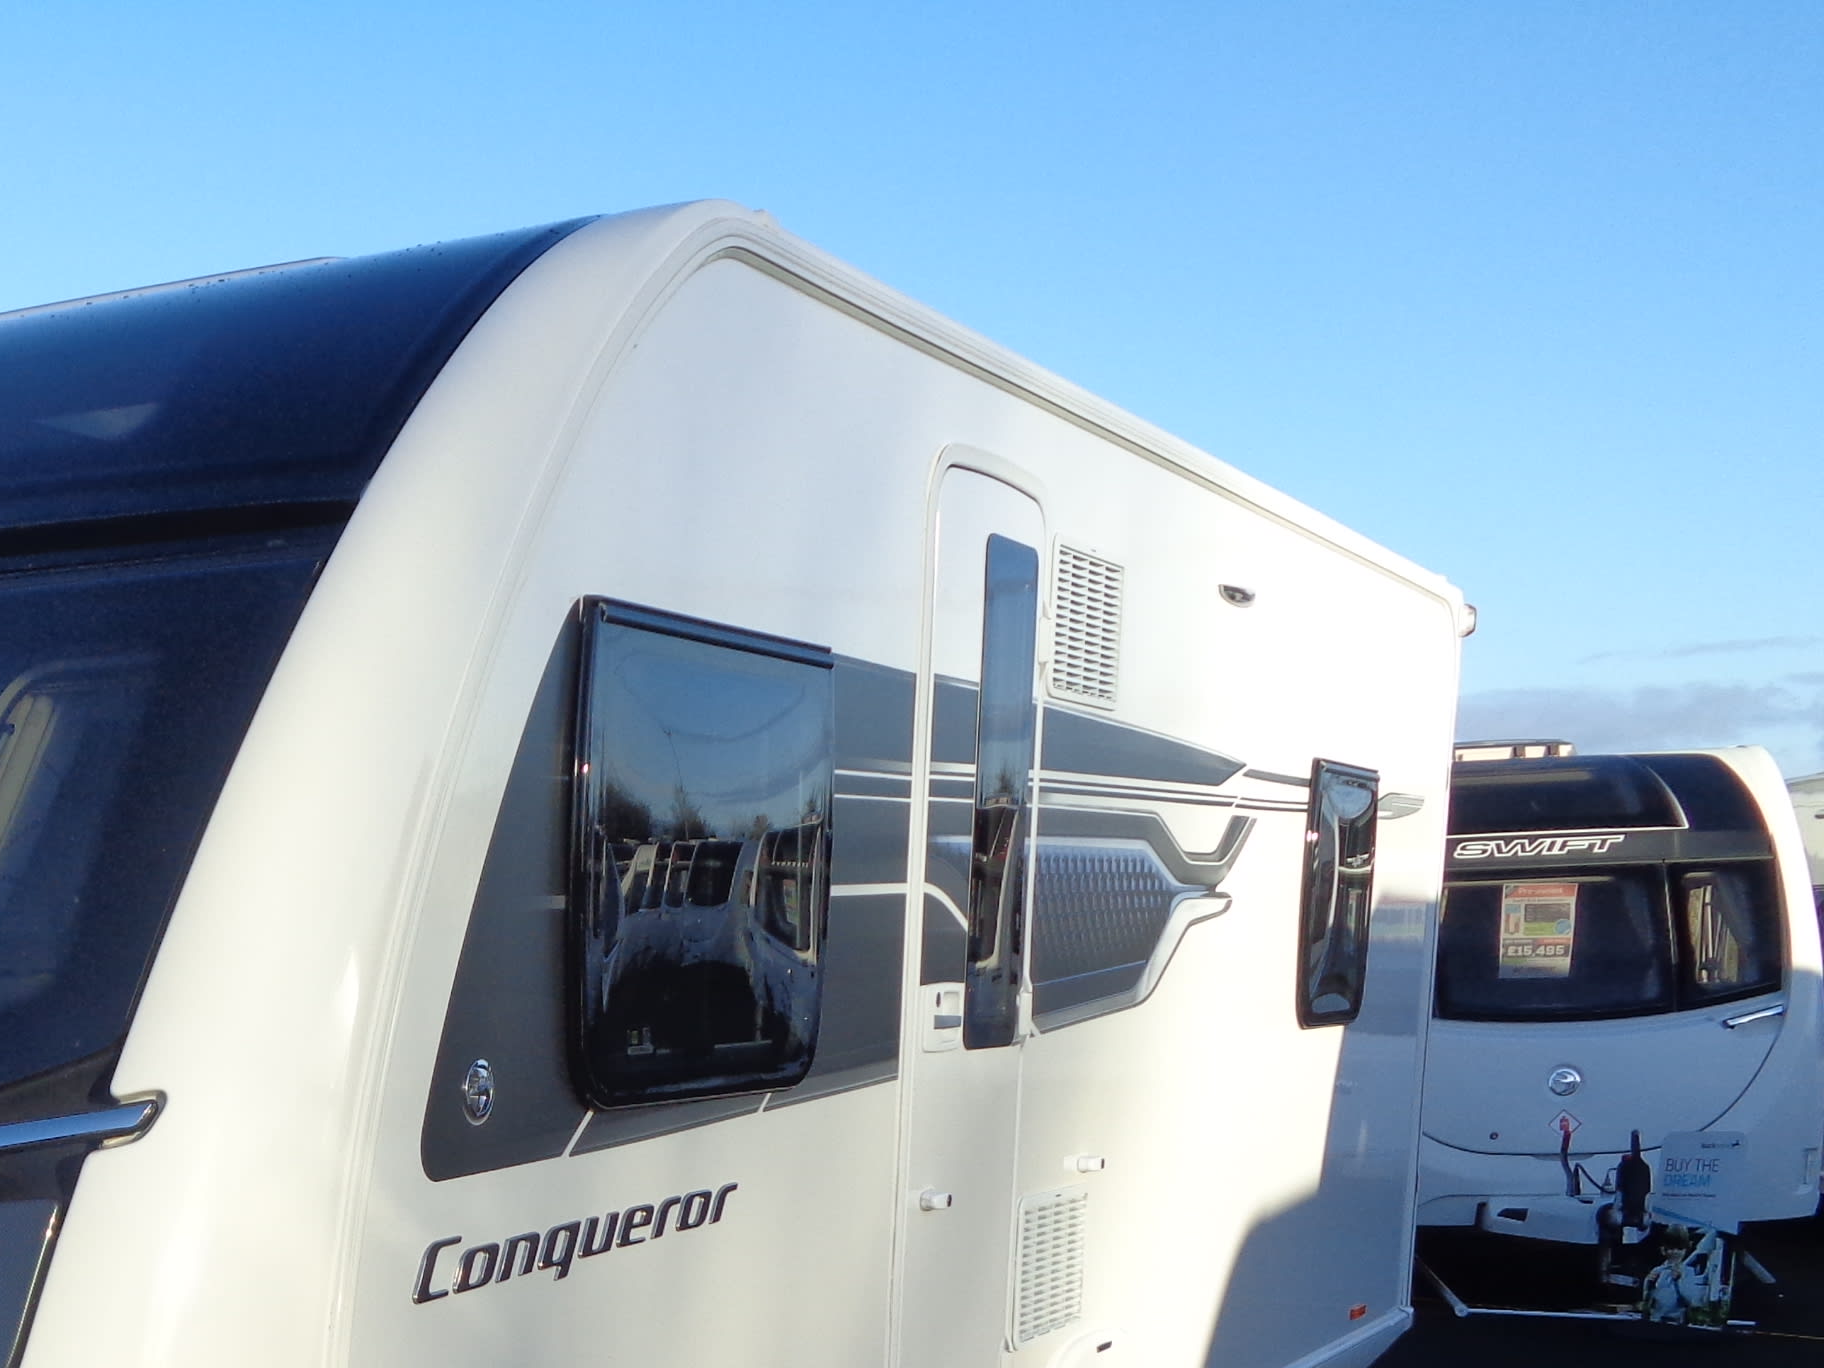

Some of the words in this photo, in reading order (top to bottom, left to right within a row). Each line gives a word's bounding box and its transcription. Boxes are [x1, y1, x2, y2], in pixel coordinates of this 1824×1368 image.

[1454, 835, 1625, 859] SWIFT
[1507, 945, 1565, 957] £15,495
[1664, 1157, 1693, 1173] BUY
[1695, 1157, 1721, 1173] THE
[1663, 1173, 1712, 1187] DREAM
[411, 1181, 739, 1305] Conqueror
